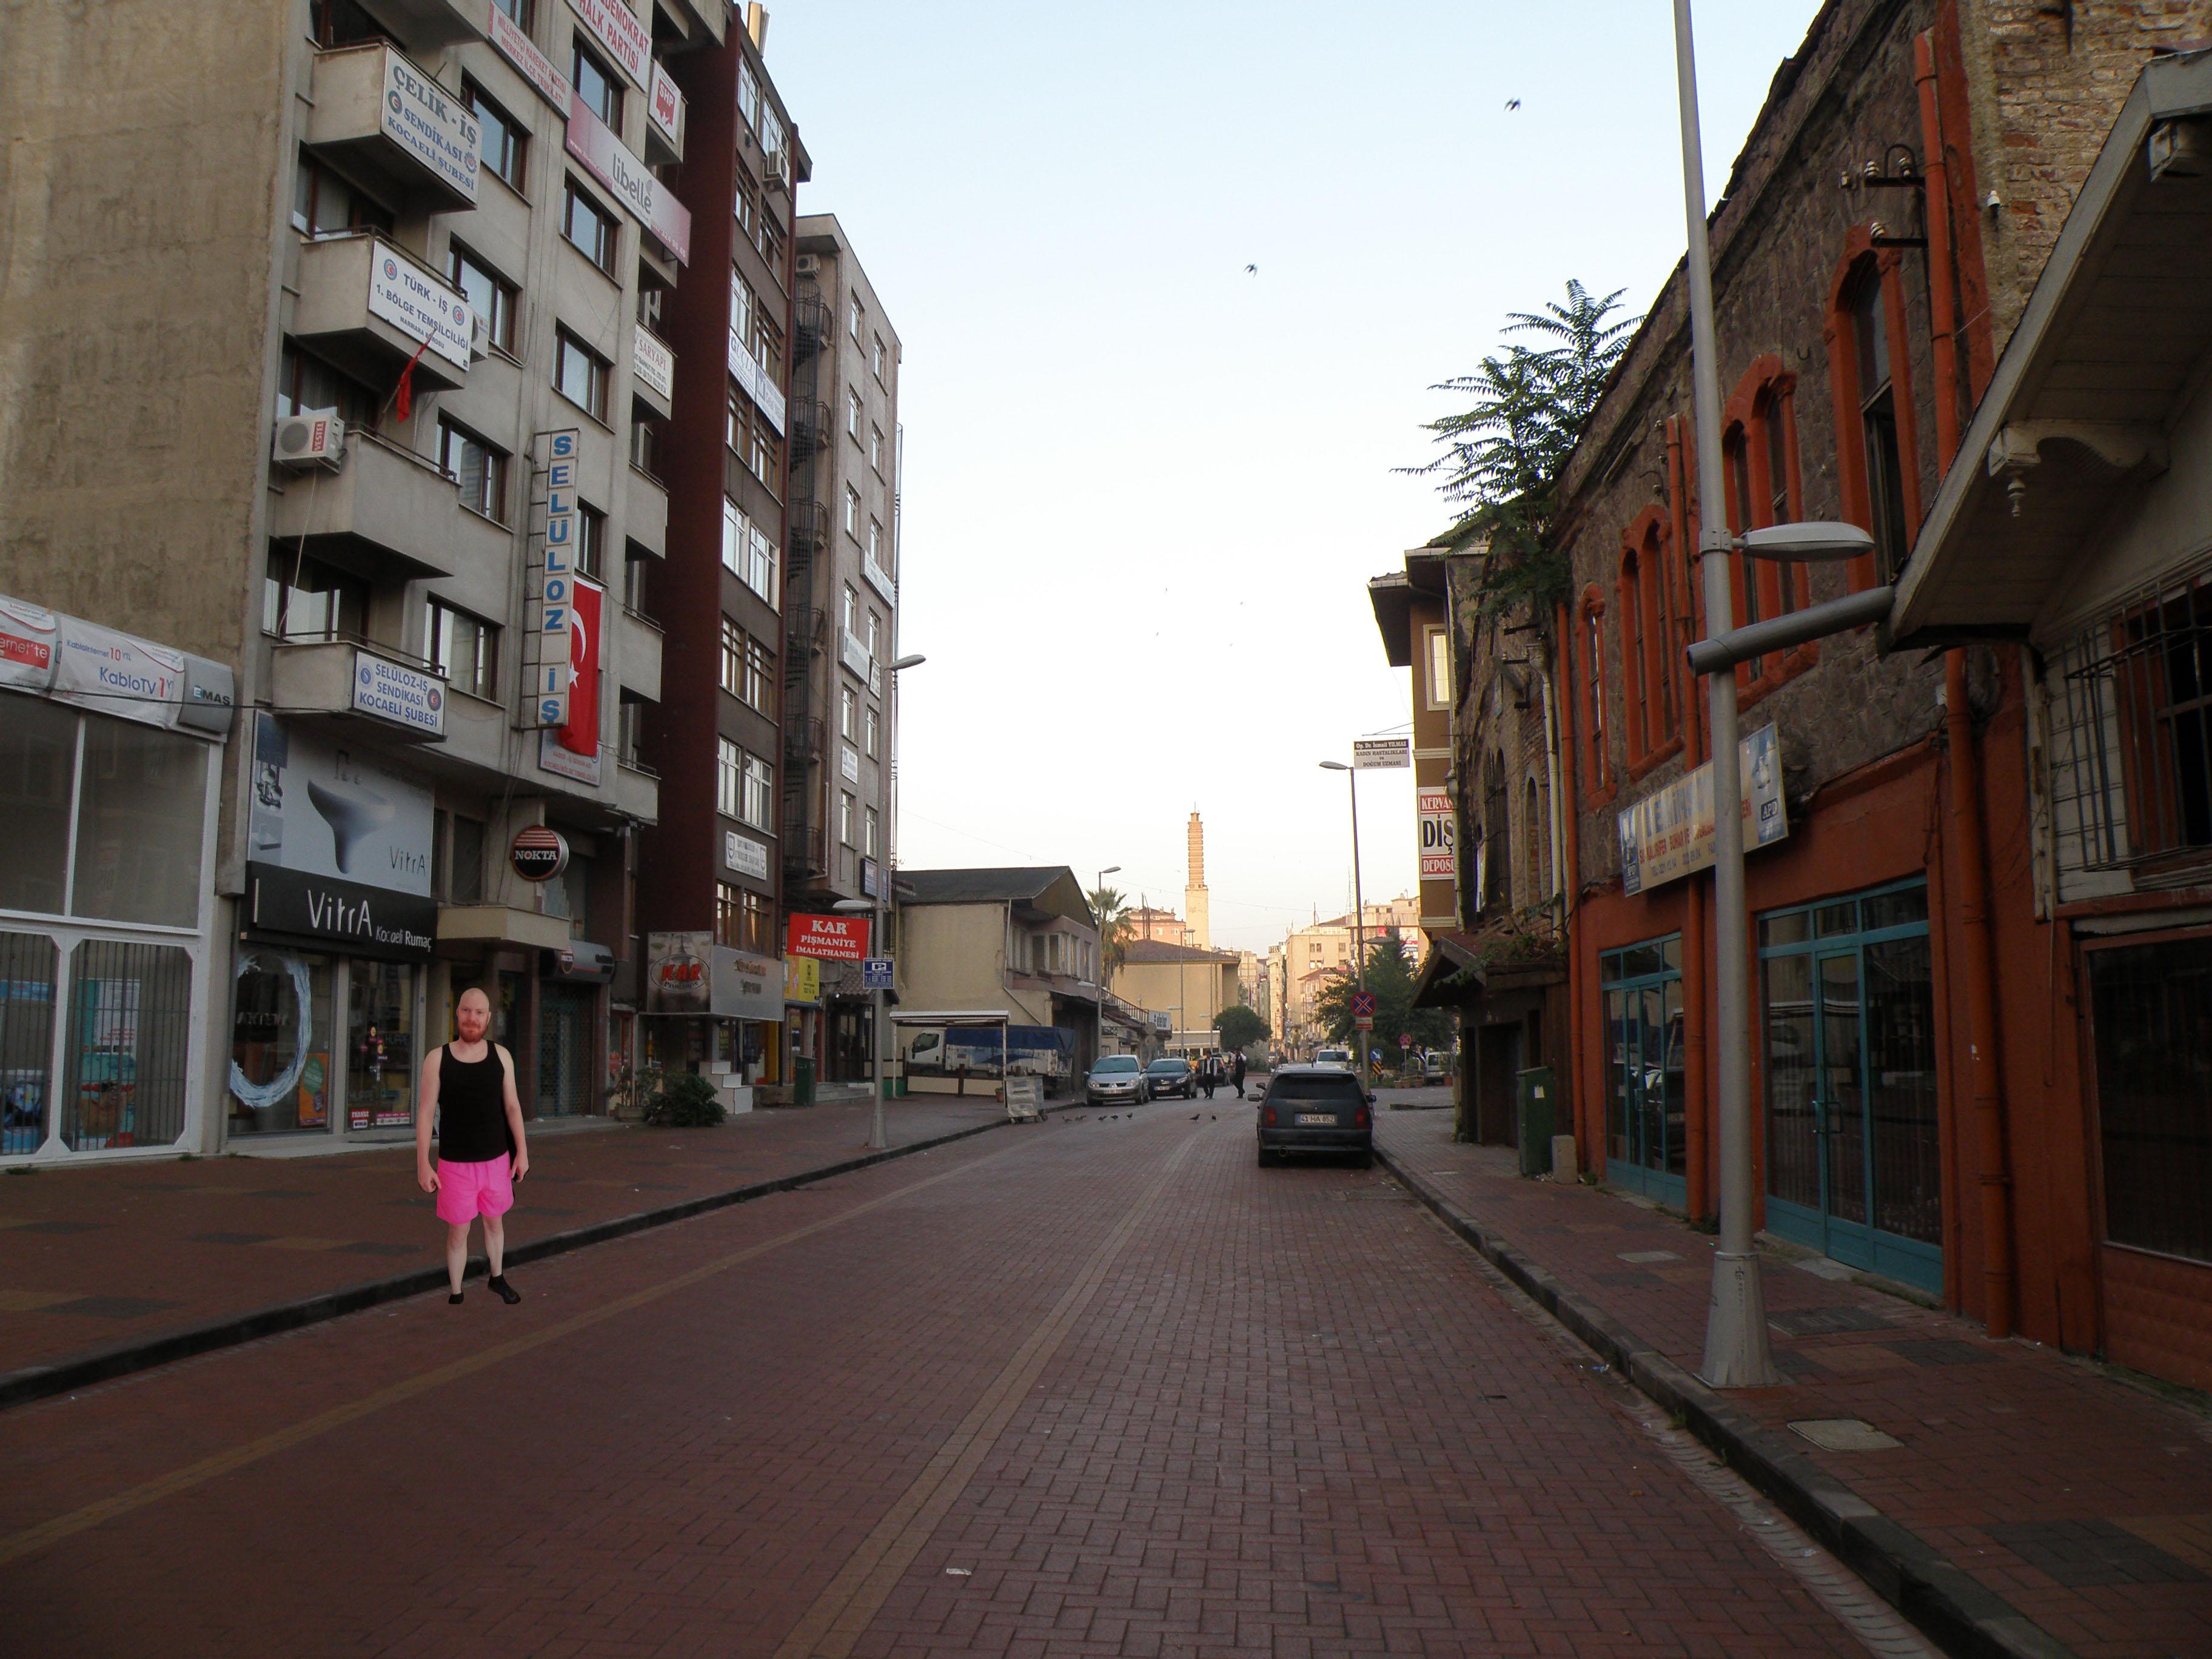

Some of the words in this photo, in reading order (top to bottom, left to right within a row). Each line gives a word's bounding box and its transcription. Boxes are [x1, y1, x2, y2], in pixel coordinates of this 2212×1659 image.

[580, 0, 604, 34] HALK
[607, 22, 638, 73] PARTİSİ
[600, 0, 649, 56] DEMOKRAT
[501, 36, 523, 64] MERKEZ
[393, 65, 448, 124] ÇELİK
[460, 114, 477, 149] İŞ
[659, 83, 674, 107] SHP
[404, 107, 463, 163] SENDİKASI
[387, 116, 435, 161] KOCAELİ
[438, 155, 475, 191] ŞUBESİ
[612, 152, 652, 215] libelle
[404, 273, 431, 301] TÜRK
[438, 295, 449, 315] İŞ
[377, 283, 384, 297] 1.
[386, 289, 415, 316] BÖLGE
[417, 309, 469, 351] TEMSİLCİLİĞİ
[400, 316, 424, 338] MARMARA
[315, 421, 324, 451] VESTEL
[545, 435, 572, 630] SELÜLOZ
[110, 647, 121, 661] 10
[99, 666, 156, 694] KabloTV
[159, 677, 165, 698] 1
[375, 663, 428, 695] SELÜLOZ-İŞ
[377, 682, 423, 707] SENDİKASI
[193, 685, 231, 706] EMAS
[360, 692, 402, 716] KOCAELİ
[405, 706, 438, 727] ŞUBESİ
[1423, 814, 1453, 855] DİŞ
[390, 846, 426, 877] VitrA
[515, 850, 557, 860] NOKTA
[307, 889, 372, 937] VitrA
[375, 926, 403, 945] Kocaeli
[405, 930, 432, 953] Rumaç
[811, 920, 848, 935] KAR
[796, 945, 859, 959] İMALATHANESİ
[800, 934, 856, 948] PİŞMANİYE
[661, 964, 702, 980] KAR
